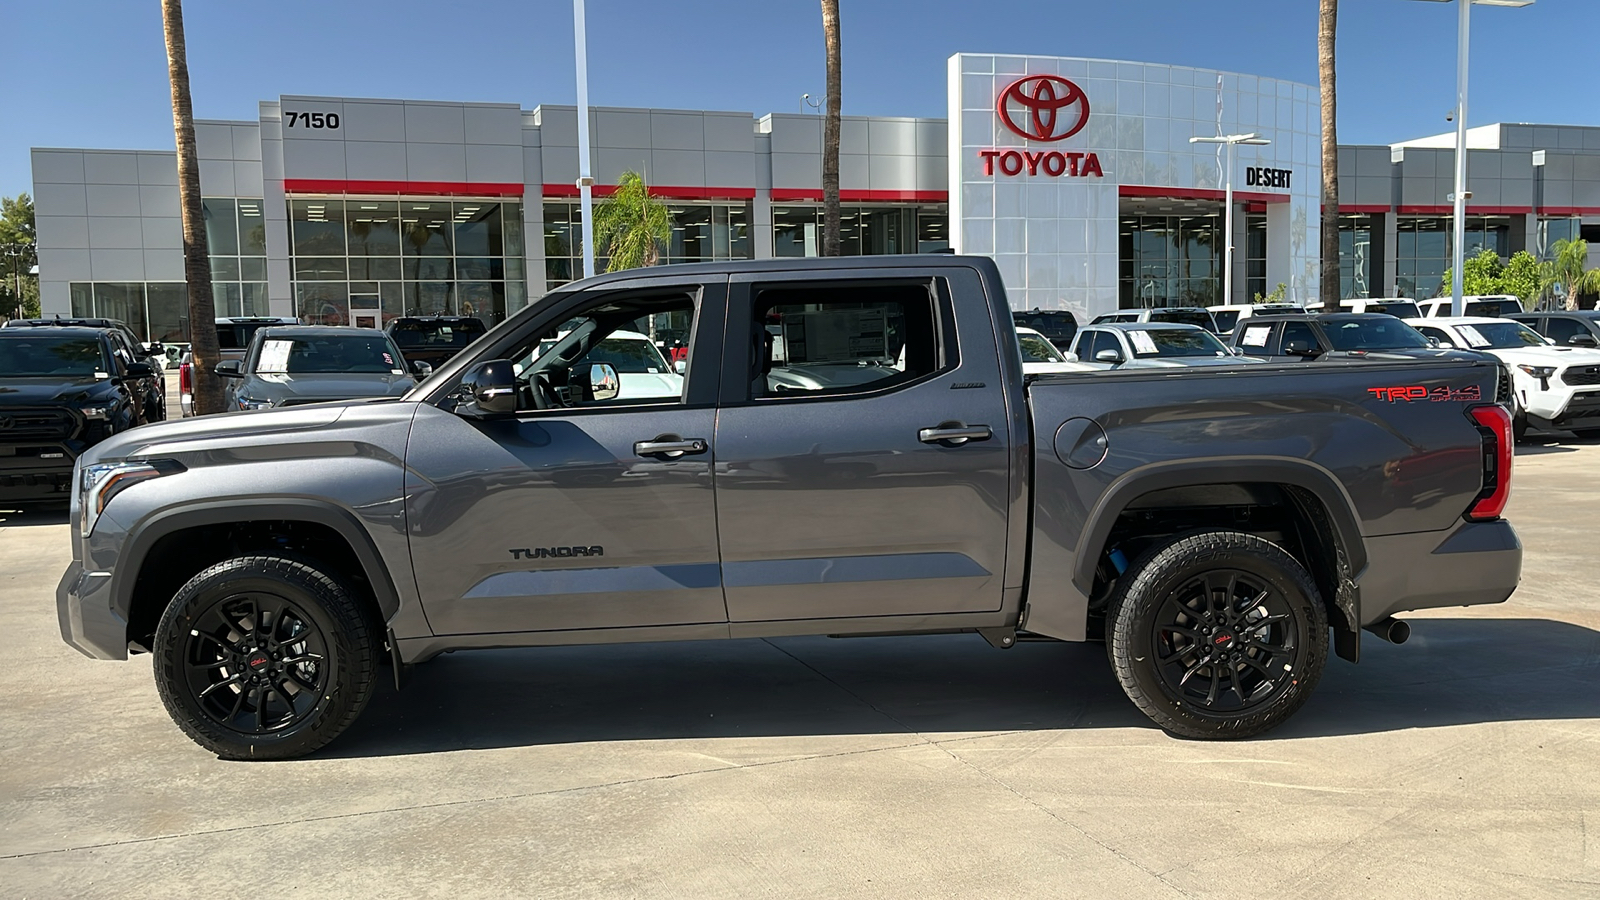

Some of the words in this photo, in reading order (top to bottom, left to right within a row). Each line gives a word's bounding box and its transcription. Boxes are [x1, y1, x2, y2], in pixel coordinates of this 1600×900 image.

[285, 111, 340, 129] 7150
[979, 150, 1104, 178] TOYOTA
[1246, 166, 1293, 189] DESERT
[1367, 385, 1430, 404] TRD
[509, 545, 604, 560] TUNDRA
